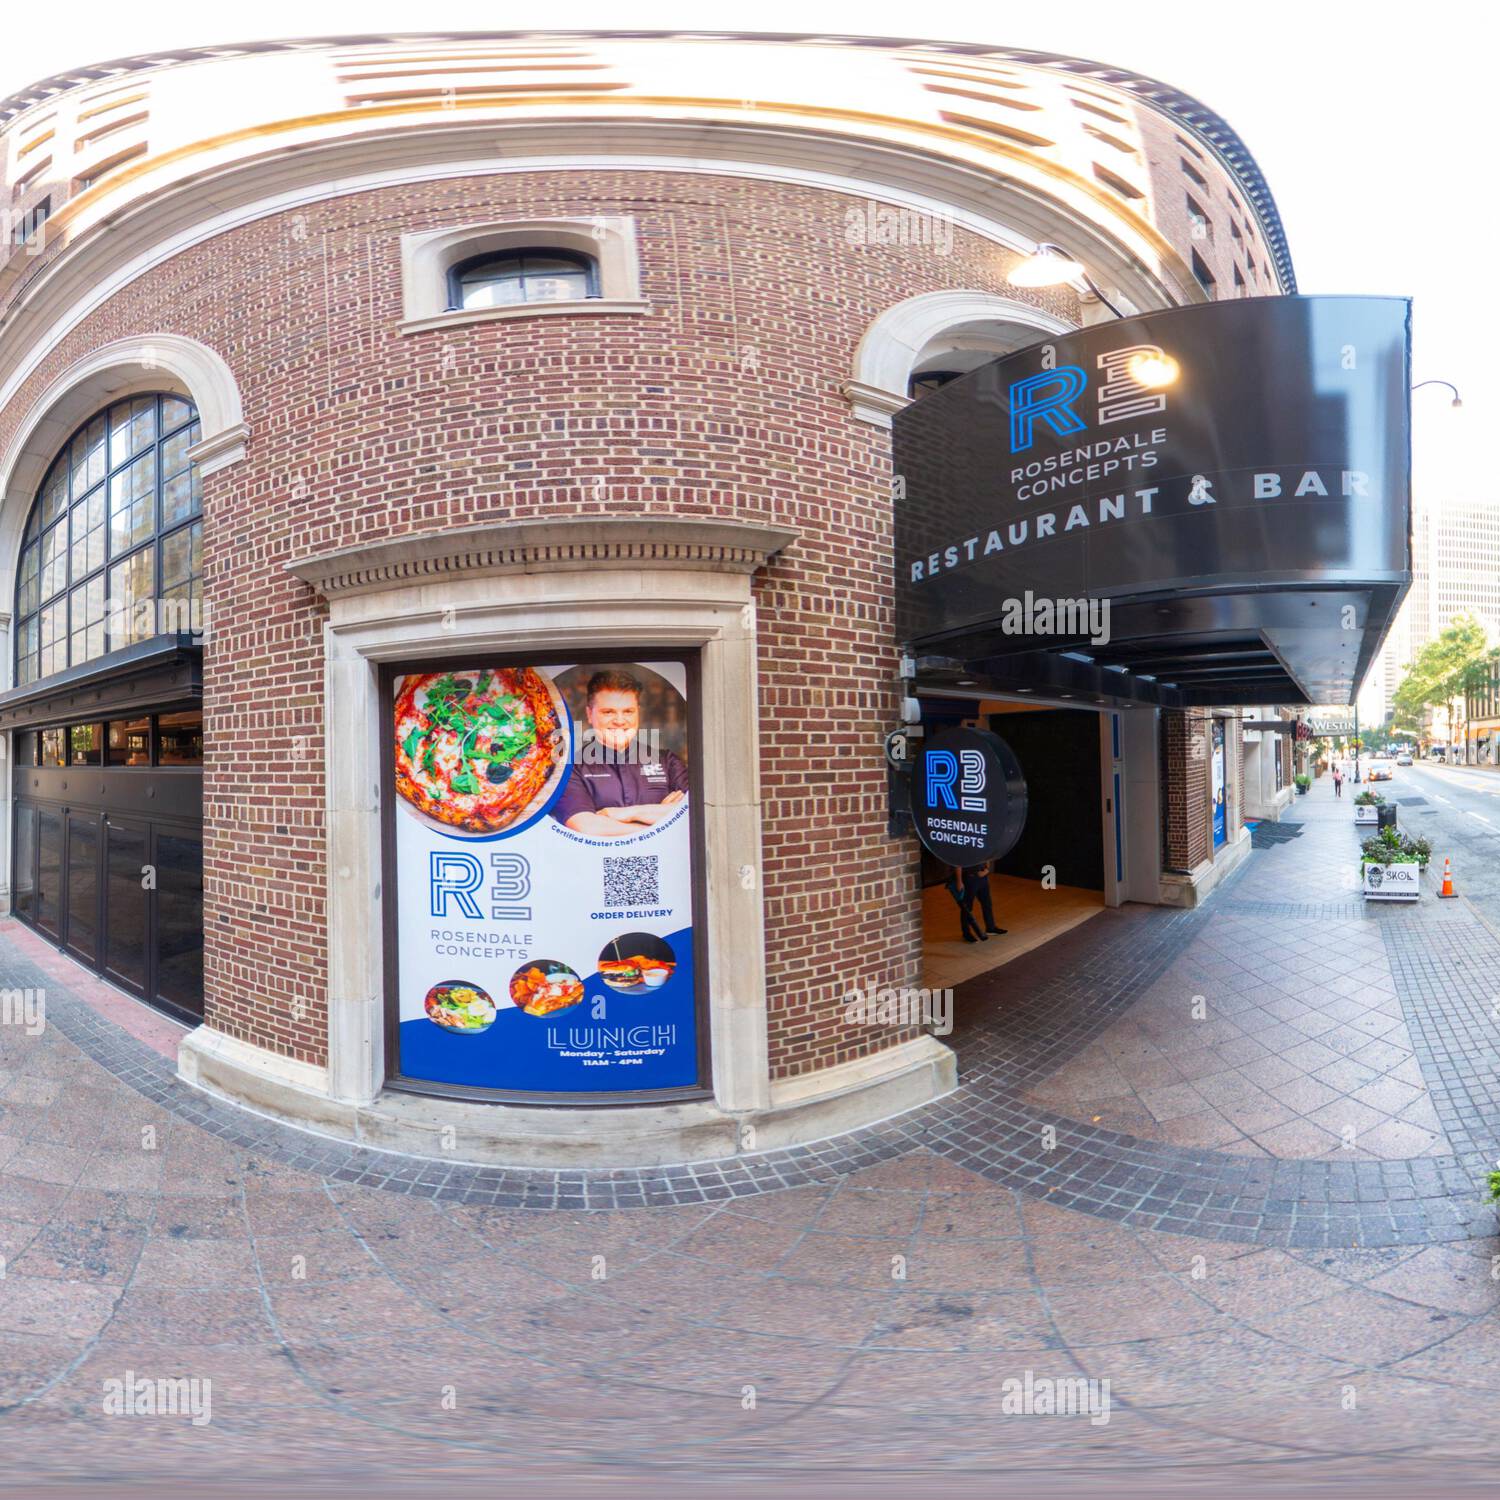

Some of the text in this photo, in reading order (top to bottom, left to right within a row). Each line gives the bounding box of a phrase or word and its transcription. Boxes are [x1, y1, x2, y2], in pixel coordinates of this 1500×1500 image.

[1011, 428, 1167, 483] ROSENDALE
[1017, 451, 1158, 501] CONCEPTS
[910, 487, 1160, 583] RESTAURANT
[1253, 470, 1370, 500] BAR
[551, 824, 583, 843] Certified
[584, 839, 613, 847] Master
[638, 831, 656, 842] Rich
[655, 804, 689, 833] Rosendale
[927, 817, 988, 835] ROSENDALE
[929, 830, 985, 848] CONCEPTS
[590, 909, 673, 920] ORDER DELIVERY
[431, 929, 533, 946] ROSENDALE
[435, 944, 528, 960] CONCEPTS
[547, 1023, 676, 1050] LUNCH
[560, 1050, 605, 1059] Monday
[614, 1048, 666, 1057] Saturday
[582, 1059, 609, 1067] 11AM
[618, 1058, 643, 1066] 4PM
